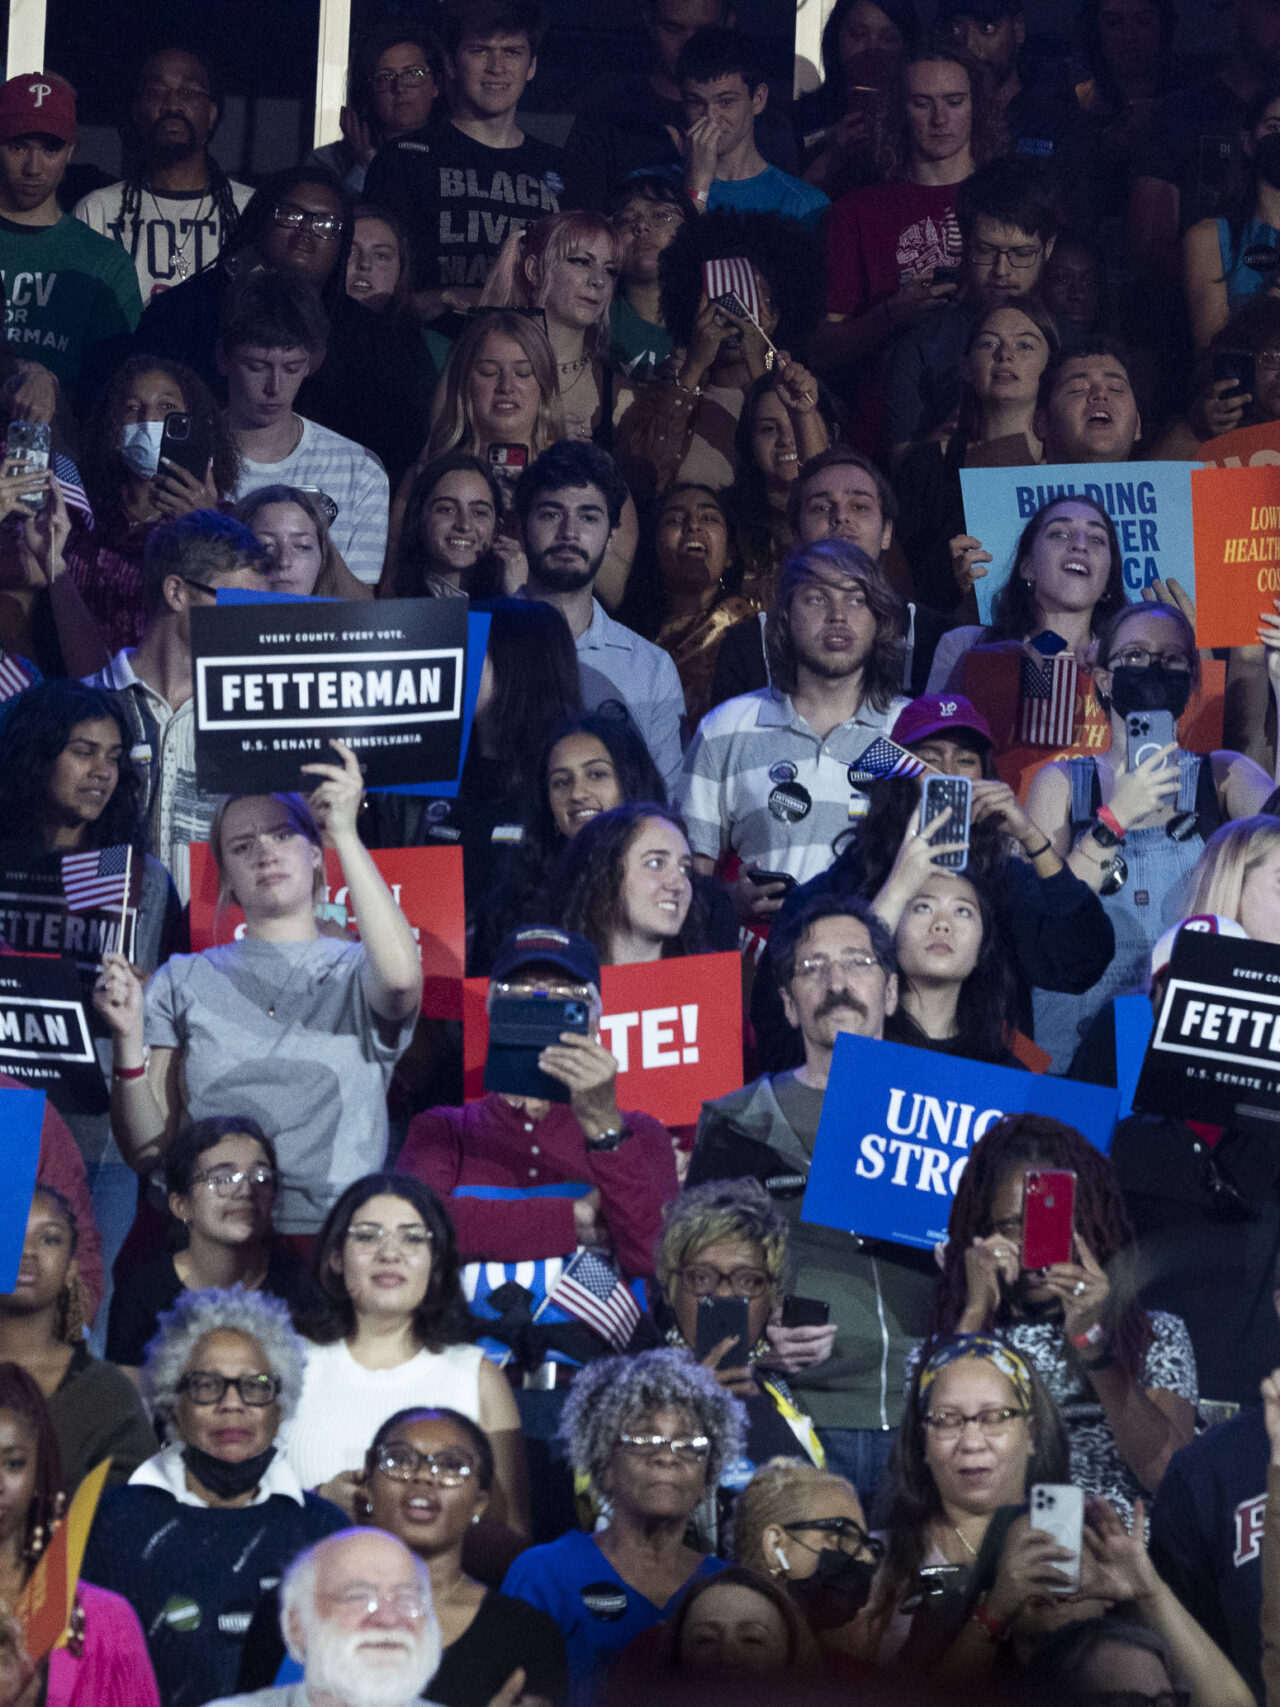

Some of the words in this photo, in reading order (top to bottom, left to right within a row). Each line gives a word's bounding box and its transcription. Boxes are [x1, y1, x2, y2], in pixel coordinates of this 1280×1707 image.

[29, 83, 52, 108] P
[438, 166, 561, 214] BLACK
[107, 218, 217, 280] VOT
[259, 633, 291, 644] EVERY
[342, 630, 374, 641] EVERY
[221, 667, 442, 712] FETTERMAN
[273, 738, 321, 750] SENATE
[1233, 967, 1264, 981] EVERY
[0, 1009, 70, 1047] MAN
[599, 1003, 699, 1074] TE!
[1215, 1071, 1262, 1090] SENATE
